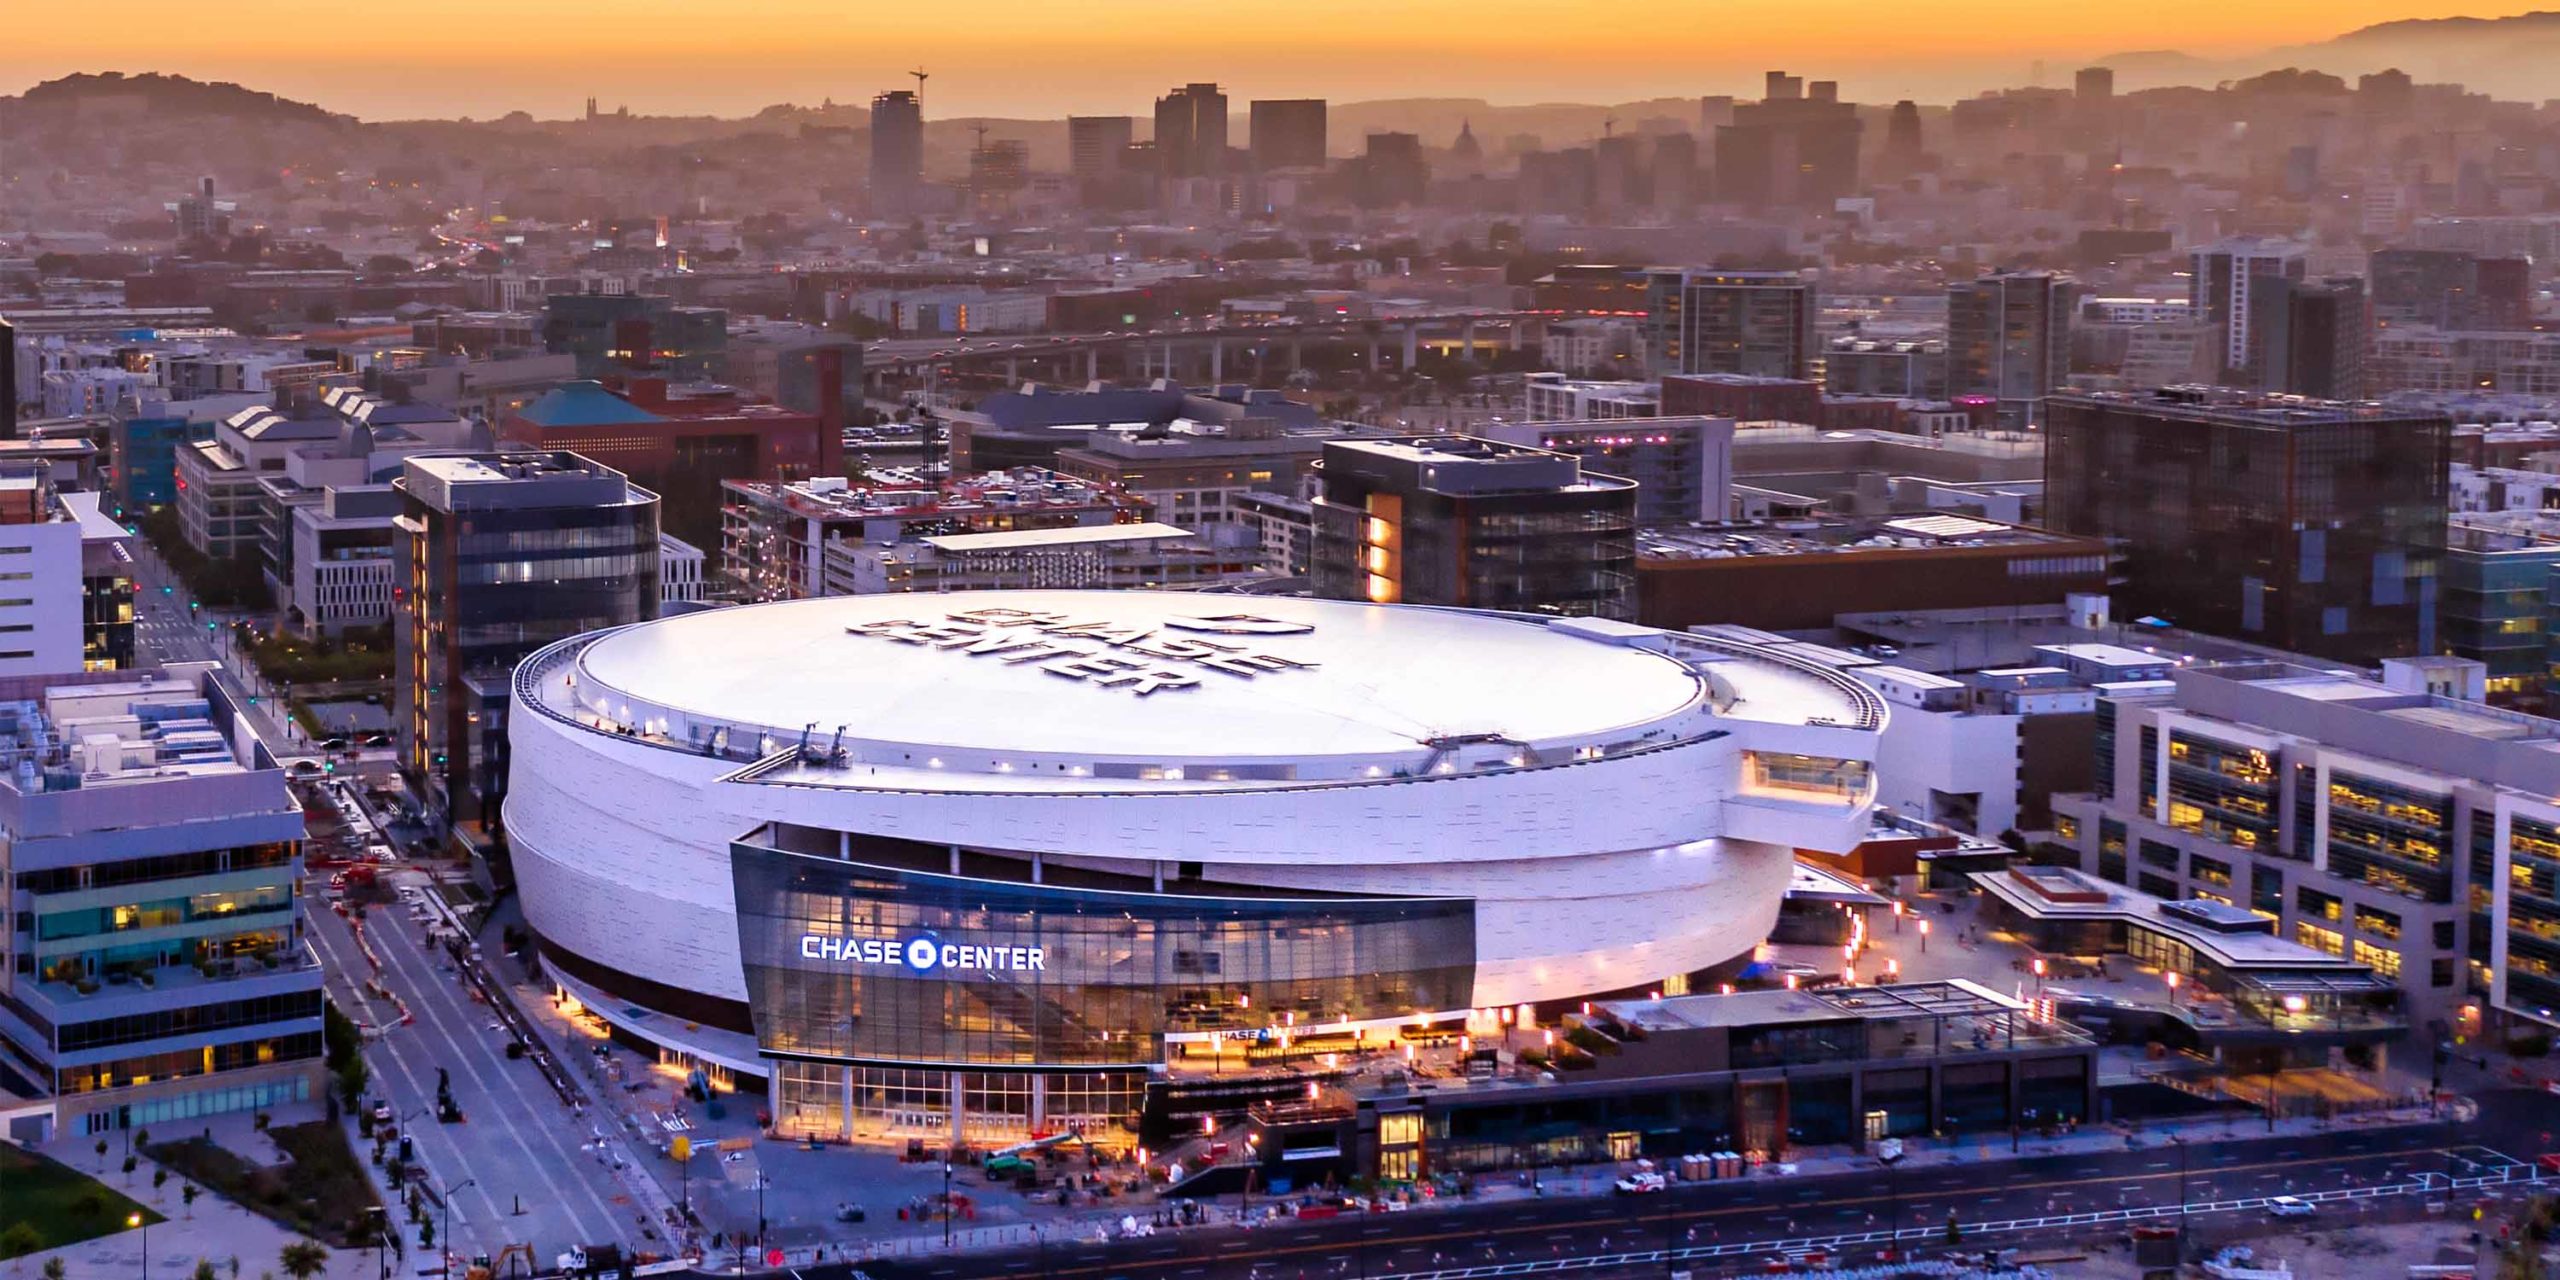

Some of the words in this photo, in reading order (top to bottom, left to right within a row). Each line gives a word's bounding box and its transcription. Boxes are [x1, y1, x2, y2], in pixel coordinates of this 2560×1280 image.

[844, 619, 1201, 697] CENTER
[945, 607, 1322, 678] CHASE
[801, 936, 903, 965] CHASE
[941, 945, 1046, 971] CENTER
[1209, 1030, 1257, 1042] HASE
